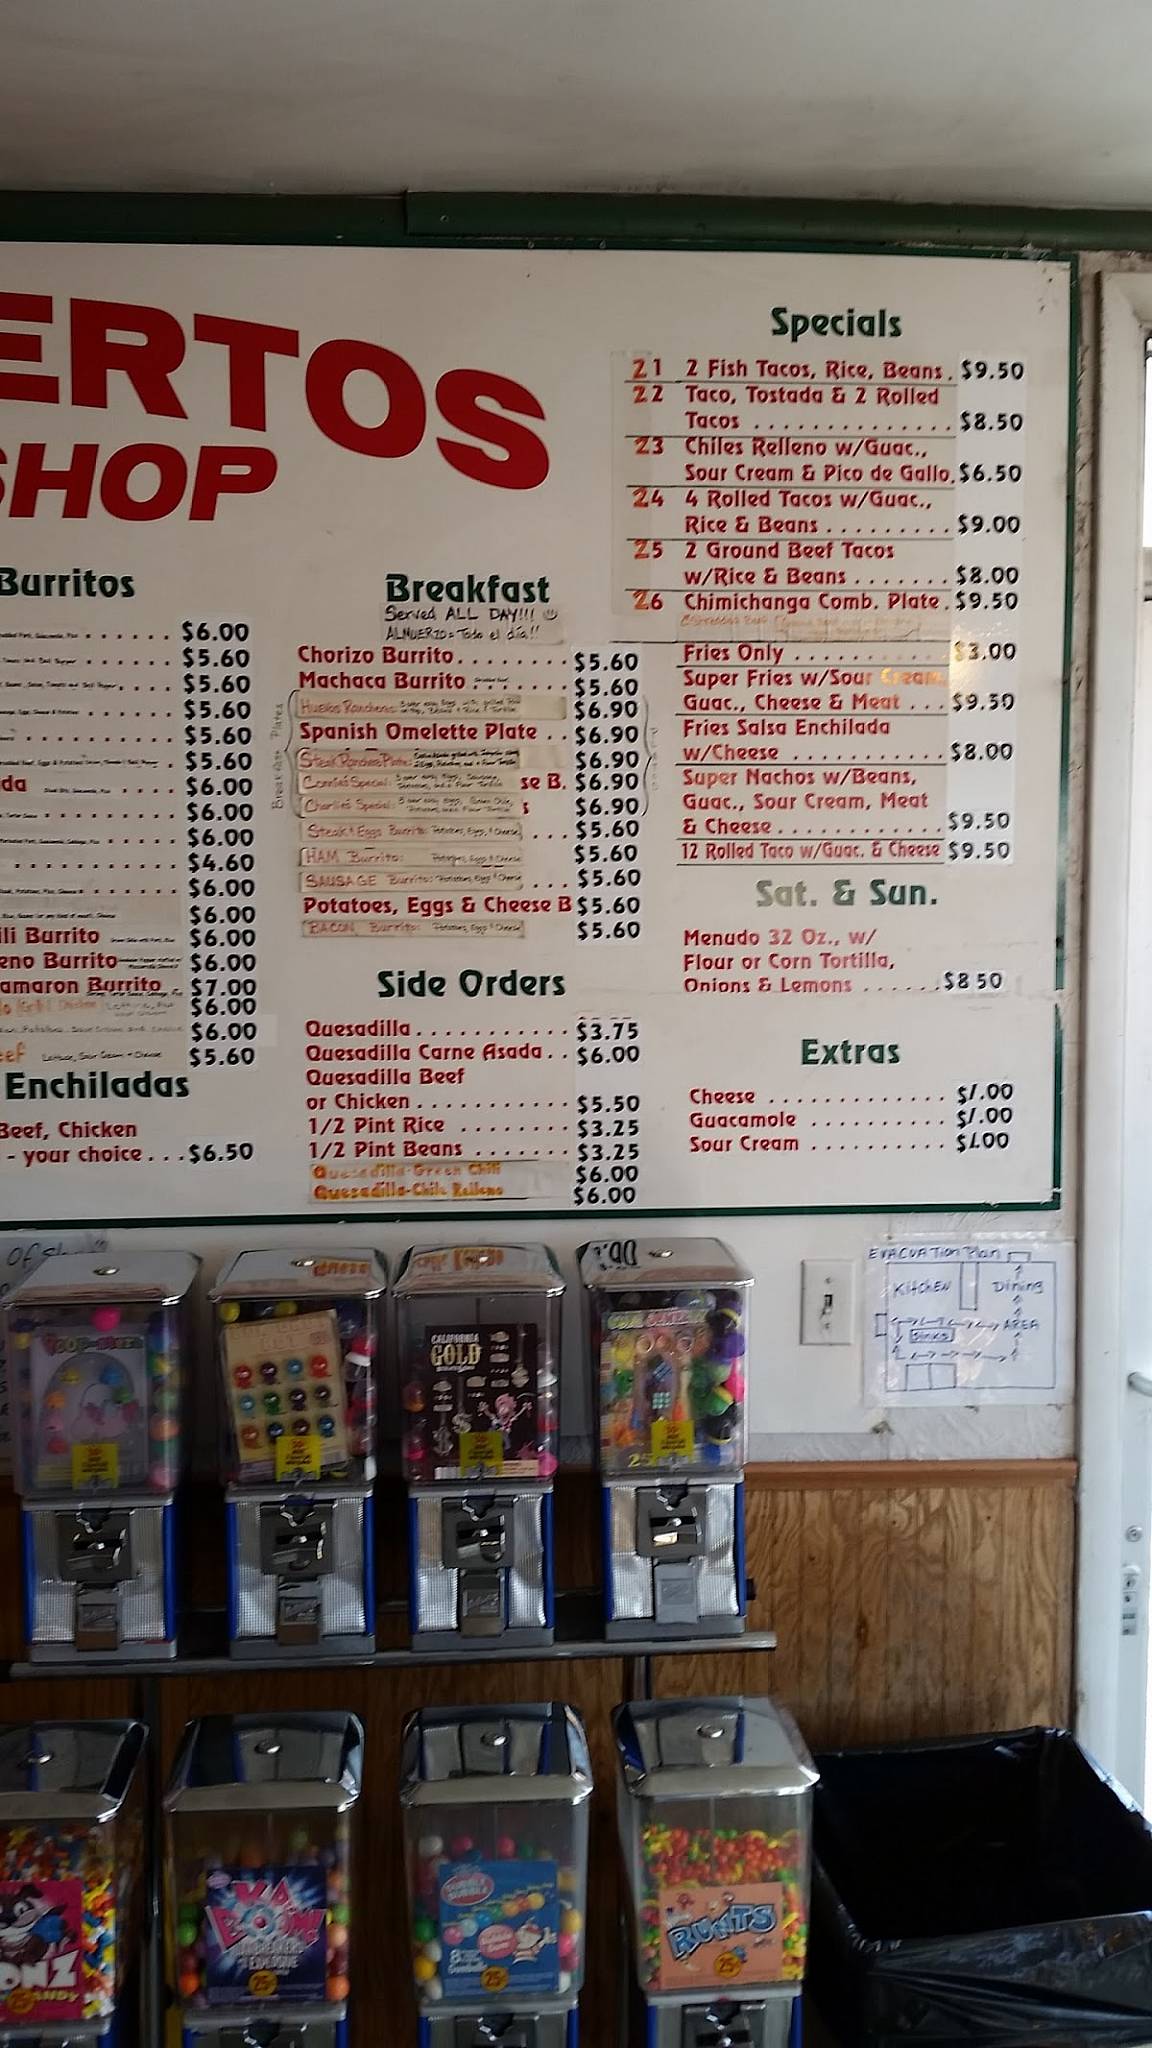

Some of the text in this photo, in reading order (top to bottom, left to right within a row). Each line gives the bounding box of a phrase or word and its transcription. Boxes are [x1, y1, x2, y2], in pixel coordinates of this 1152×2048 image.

[771, 308, 902, 342] Specials
[708, 359, 1023, 381] Fish Tacos, Rice, $9.50
[686, 386, 939, 405] Taco, Tostada Rolled
[686, 412, 1023, 432] Tacos $8.50
[686, 437, 826, 456] Chiles Relleno
[686, 464, 1021, 484] Sour Cream Pico de $6.50
[708, 490, 831, 508] Rolled Tacos
[685, 516, 1020, 534] Rice Beans $9.00
[707, 541, 894, 559] Ground Beef Tacos
[0, 567, 135, 598] Burritos
[685, 566, 1018, 586] w/Rice Beans $8.00
[386, 574, 550, 603] Breakfast
[685, 593, 1018, 613] Chimichanga Comb. $9.50
[385, 605, 534, 622] Served ALL DAY!!!
[298, 645, 454, 664] Chorizo Burrito
[684, 643, 783, 664] Fries Only
[299, 671, 465, 689] Machaca Burrito
[684, 670, 872, 689] Super Fries w/Sour
[684, 693, 1014, 712] Guac., Cheese Meat $9.50
[300, 722, 537, 743] Spanish Omelette Plate
[684, 718, 890, 737] Fries Salsa Enchilada
[683, 743, 1013, 761] w/Cheese $8.00
[683, 767, 916, 787] Super Nachos w/Beans,
[683, 793, 928, 811] Guac., Sour Cream, Meat
[705, 811, 1009, 833] Cheese $9.50
[682, 841, 1010, 860] 12 Rolled Taco w/Guac. Cheese $9.50
[189, 853, 254, 872] $4.60
[757, 879, 938, 907] Sat. Sun.
[303, 896, 551, 917] Potatoes, Eggs Cheese
[26, 927, 99, 944] Burrito
[684, 929, 877, 946] Menudo 32 w/
[44, 953, 117, 969] Burrito
[684, 953, 895, 971] Flour or Corn Tortilla,
[88, 977, 161, 992] Burrito
[191, 977, 256, 997] $7.00
[377, 969, 566, 998] Side Orders
[684, 977, 750, 992] Onions
[781, 977, 852, 992] Lemons
[306, 1020, 639, 1042] Quesadilla $3.75
[306, 1043, 640, 1067] Quesadilla Carne Asada $6.00
[801, 1038, 901, 1065] Extras
[5, 1071, 189, 1099] Enchiladas
[306, 1068, 465, 1086] Quesadilla Beef
[307, 1092, 640, 1114] or Chicken $5.50
[689, 1082, 1013, 1104] Cheese $1.00
[308, 1117, 640, 1138] 1/2 Pint Rice $3.25
[690, 1106, 1013, 1129] Guacamole $1.00
[0, 1122, 137, 1140] Beef, Chicken
[308, 1141, 640, 1162] 1/2 Pint Beans $3.25
[690, 1135, 799, 1152] Sour Cream
[24, 1144, 254, 1167] your choice $6.50
[576, 1165, 639, 1185] $6.00
[575, 1187, 636, 1205] $6.00
[431, 1333, 479, 1344] CALIFORNIA
[431, 1344, 481, 1367] GOLD
[667, 1904, 777, 1960] RUNTS
